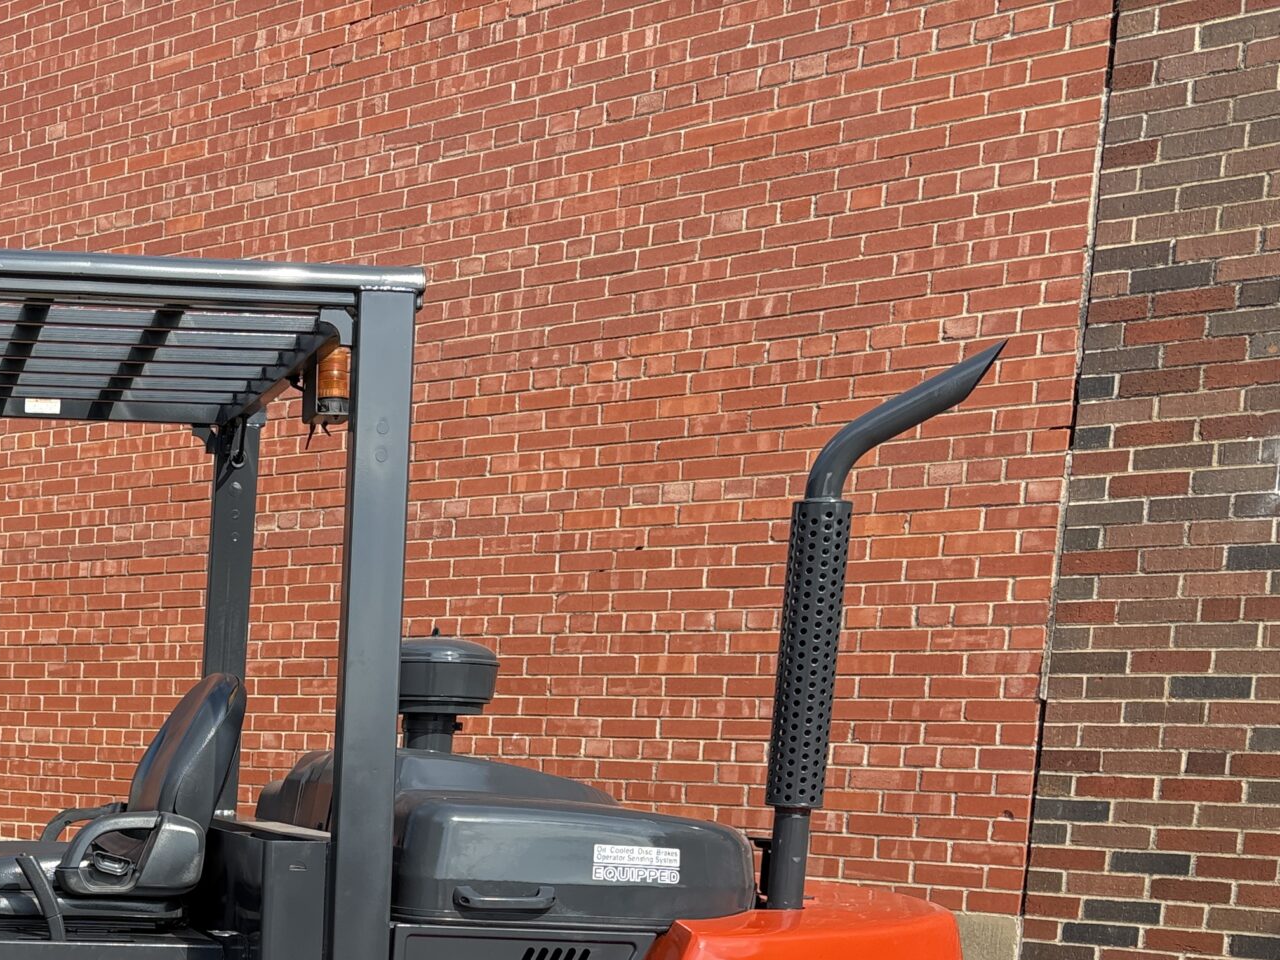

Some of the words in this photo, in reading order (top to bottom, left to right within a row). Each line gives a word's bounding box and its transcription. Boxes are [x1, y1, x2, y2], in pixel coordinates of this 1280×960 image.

[596, 845, 607, 854] Oil
[609, 846, 635, 855] Cooled
[637, 847, 653, 856] Disc
[656, 848, 678, 857] Brakes
[596, 853, 626, 862] Operator
[655, 856, 678, 865] System
[592, 866, 680, 885] EQUIPPED
